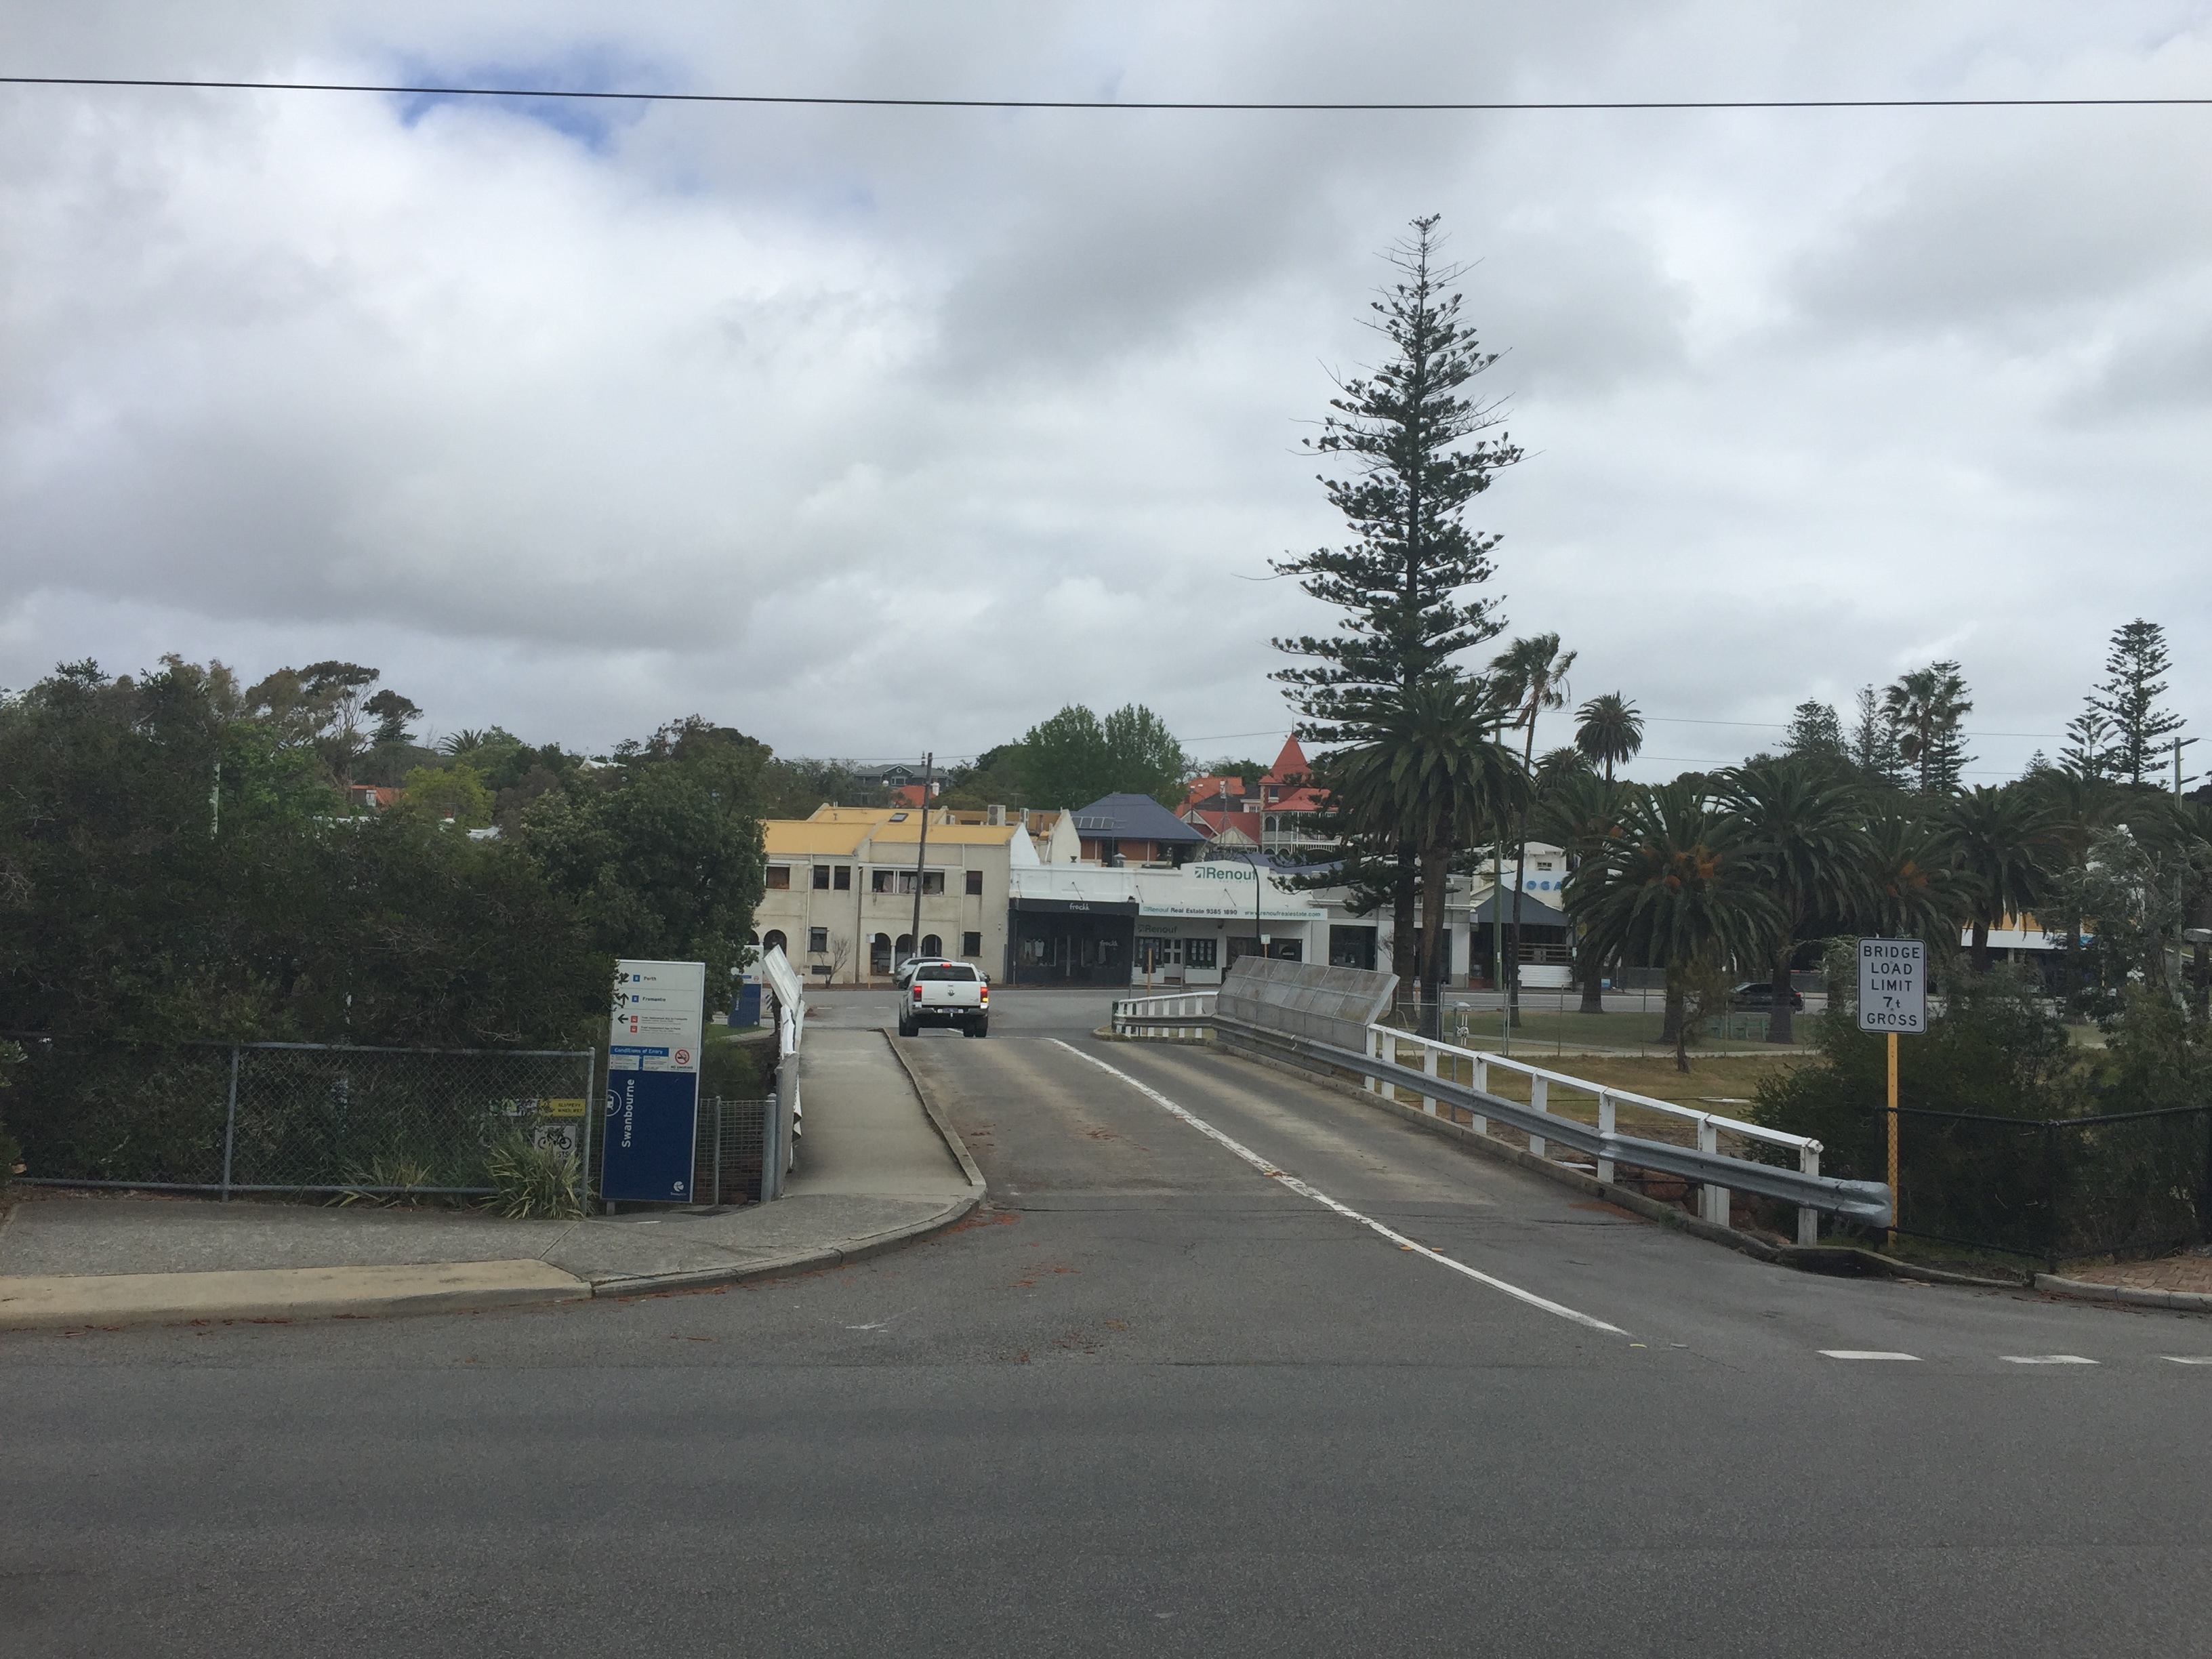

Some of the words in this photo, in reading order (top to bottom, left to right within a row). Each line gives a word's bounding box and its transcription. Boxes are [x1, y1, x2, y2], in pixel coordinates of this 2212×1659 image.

[1145, 925, 1177, 933] Renouf
[1864, 945, 1920, 958] BRIDGE
[1871, 962, 1912, 975] LOAD
[1871, 979, 1912, 991] LIMIT
[1867, 1012, 1917, 1026] GROSS
[621, 1079, 635, 1147] Swanbourne
